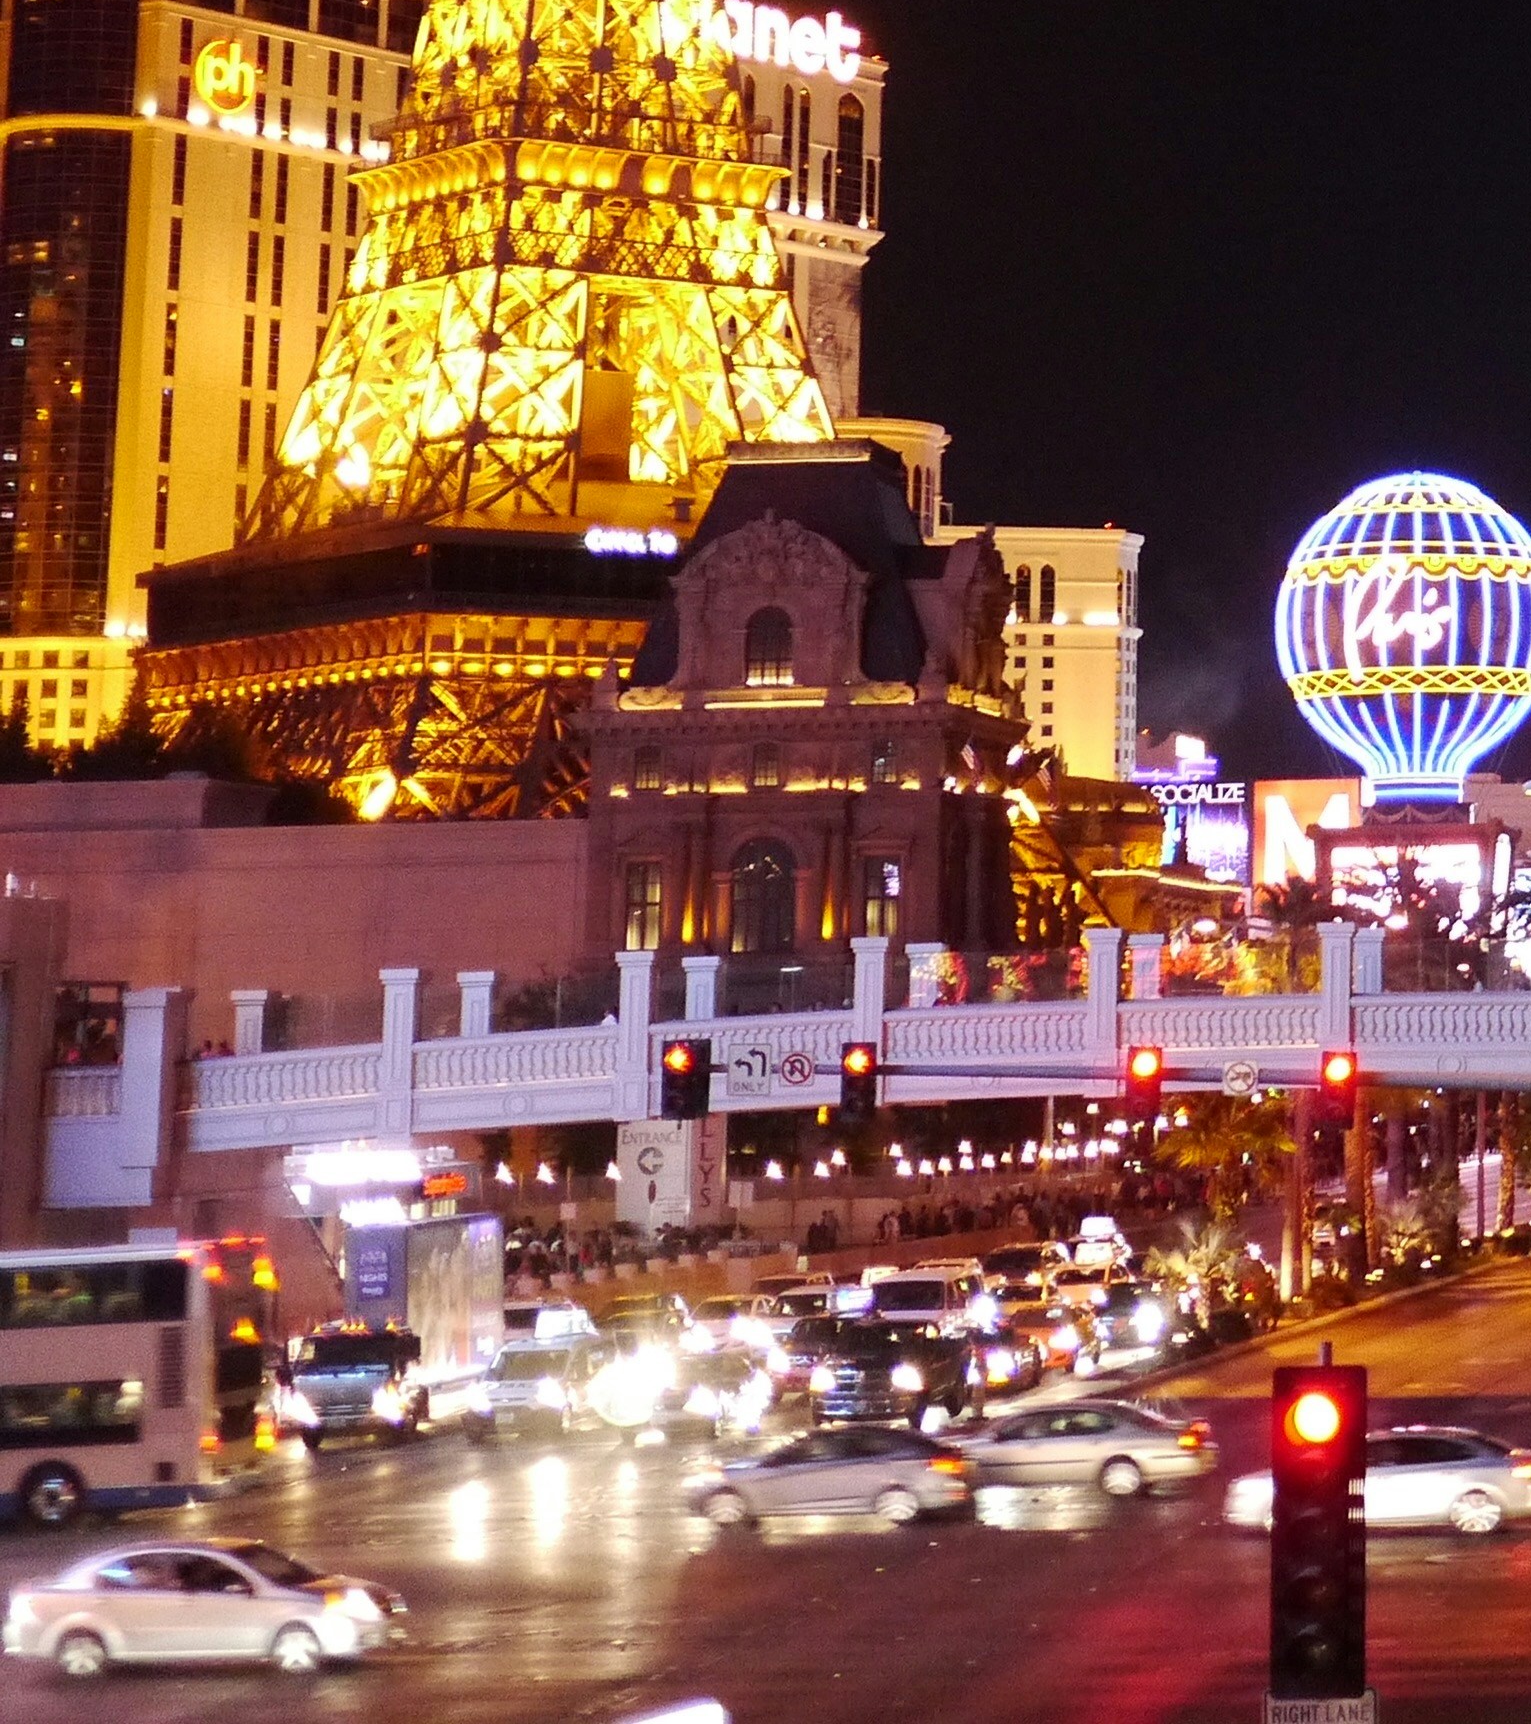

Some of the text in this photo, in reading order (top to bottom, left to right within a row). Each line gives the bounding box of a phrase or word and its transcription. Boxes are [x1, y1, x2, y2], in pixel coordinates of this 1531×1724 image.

[202, 42, 255, 103] ph
[1151, 782, 1246, 805] SOCIALIZE
[733, 1081, 765, 1092] ONLY
[621, 1129, 683, 1145] ENTRANCE
[1271, 1703, 1372, 1724] RIGHT LANE
